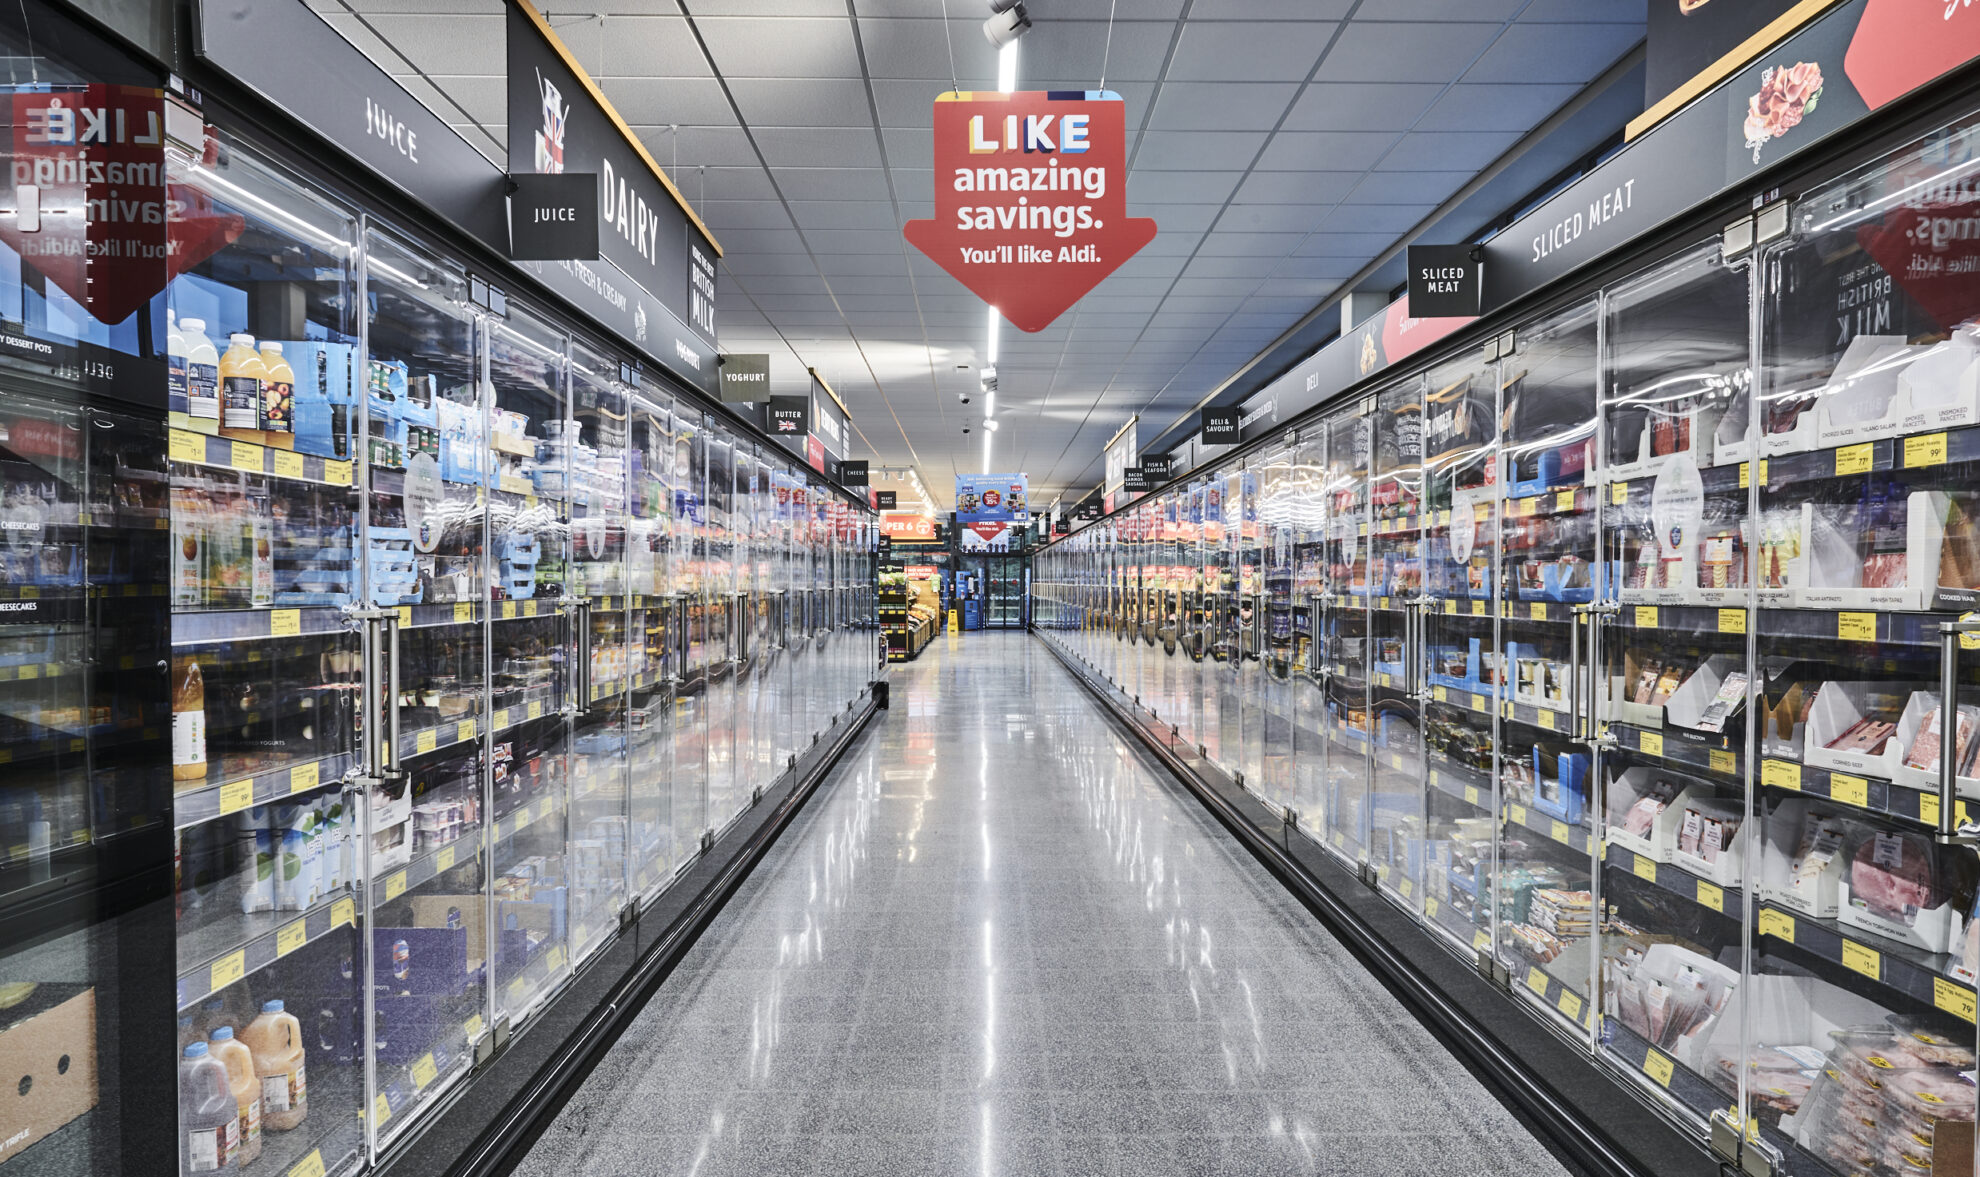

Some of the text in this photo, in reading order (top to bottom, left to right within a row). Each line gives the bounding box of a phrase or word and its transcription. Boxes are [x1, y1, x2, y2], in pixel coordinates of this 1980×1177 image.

[366, 96, 418, 164] JUICE
[969, 114, 1090, 154] LIKE
[953, 157, 1105, 199] amazing
[534, 208, 576, 223] JUICE
[603, 157, 658, 266] DAIRY
[957, 196, 1104, 238] savings.
[1532, 178, 1635, 263] SLICED MEAT
[960, 244, 1102, 264] You'll like Aldi.
[1422, 267, 1464, 280] SLICED
[574, 259, 597, 291] FRESH
[603, 281, 627, 313] CREAMY
[692, 262, 715, 302] BRITISH
[1428, 281, 1460, 293] MEAT
[693, 288, 715, 337] MILK
[6, 335, 34, 350] DESSERT
[34, 342, 52, 354] POTS
[726, 373, 765, 382] YOGHURT
[1306, 371, 1319, 392] DELI
[775, 410, 801, 418] BUTTER
[1905, 414, 1924, 422] SMOKED
[1939, 406, 1968, 417] UNSMOKED
[1940, 413, 1966, 422] PANCETTA
[1206, 425, 1234, 433] SAVOURY
[1902, 420, 1926, 428] PANCETTA
[1, 520, 40, 531] CHEESECAKES
[906, 522, 913, 530] 6
[1939, 593, 1961, 601] COOKED
[1832, 759, 1851, 767] CORNED
